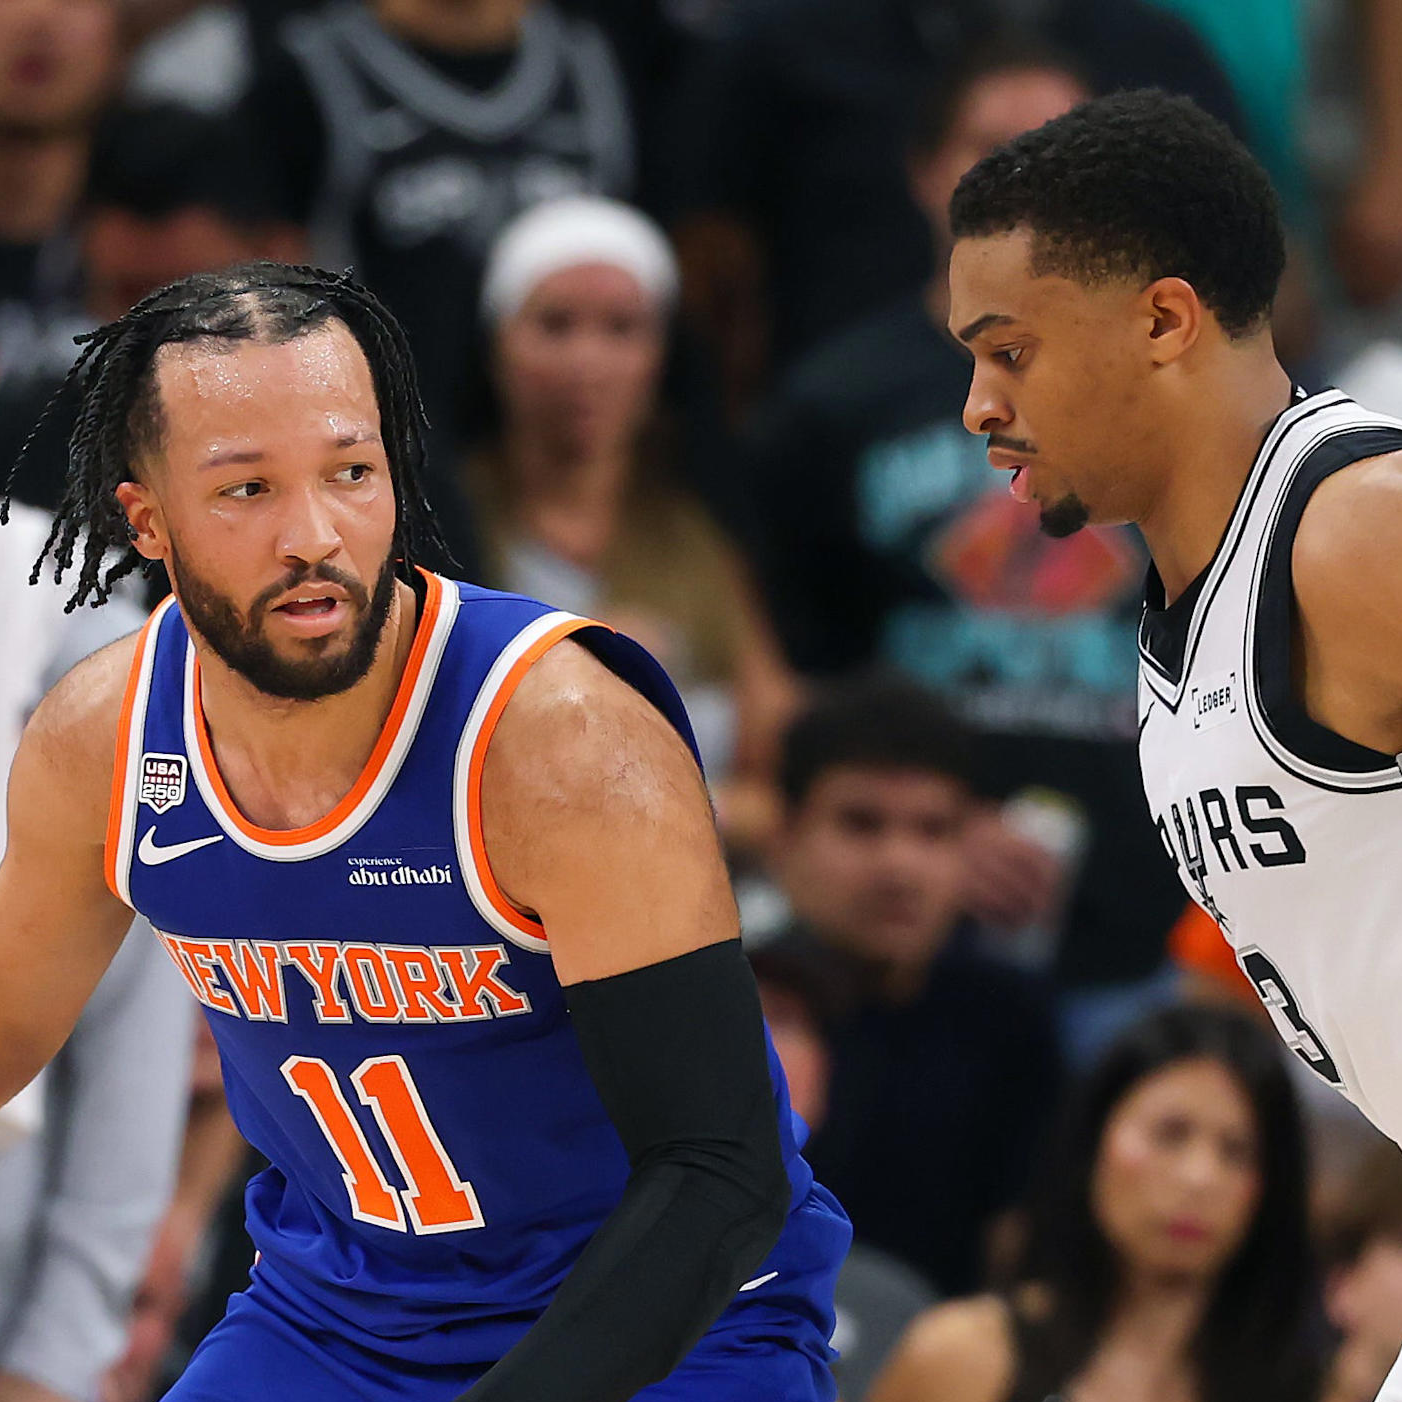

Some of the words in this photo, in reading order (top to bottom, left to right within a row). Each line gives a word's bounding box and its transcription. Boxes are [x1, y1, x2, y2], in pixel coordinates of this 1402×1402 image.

[1197, 685, 1232, 716] LEDGER
[145, 761, 180, 777] USA
[142, 783, 181, 801] 250
[348, 857, 403, 867] experience
[348, 865, 389, 886] abu
[391, 864, 453, 885] dhabi
[282, 939, 533, 1024] YORK
[279, 1054, 486, 1236] 11
